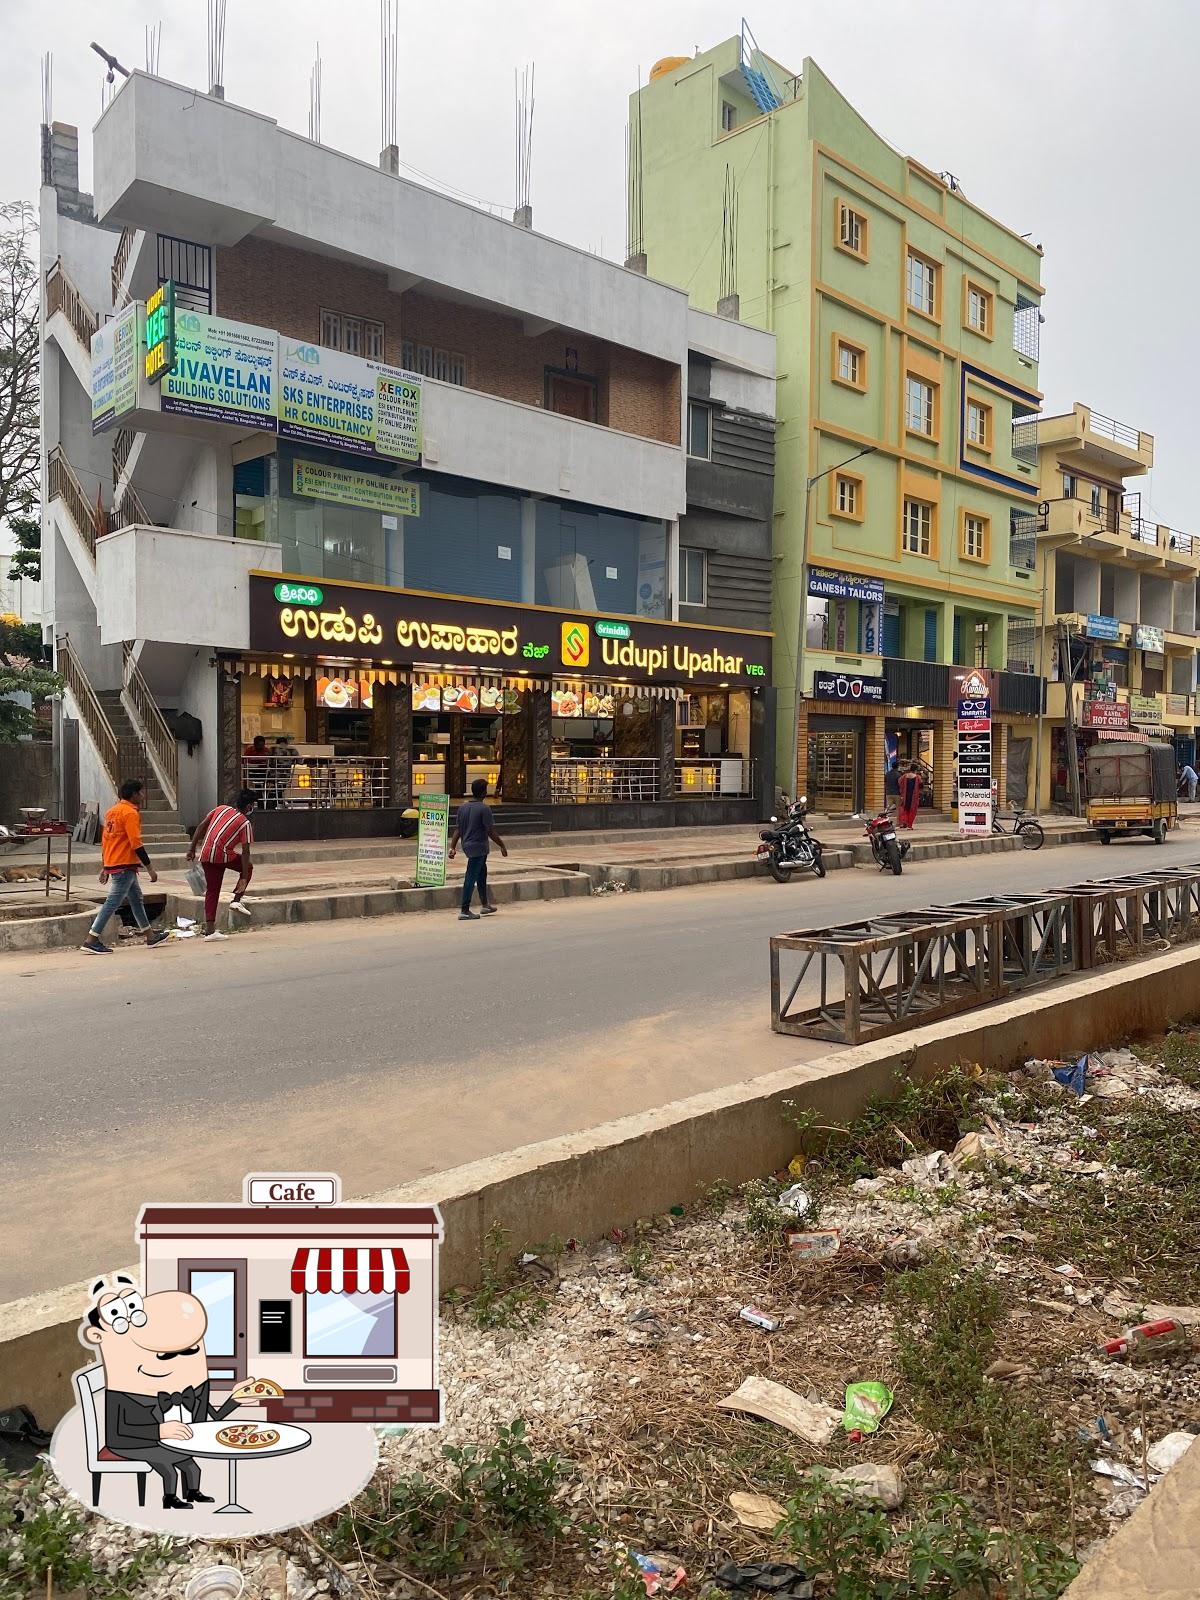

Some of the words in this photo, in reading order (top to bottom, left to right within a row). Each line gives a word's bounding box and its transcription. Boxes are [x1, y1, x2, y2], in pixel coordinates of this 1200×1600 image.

[147, 305, 165, 350] VEG
[146, 341, 165, 379] HOTEL
[168, 379, 215, 401] BUILDING
[218, 389, 271, 411] SOLUTIONS
[378, 393, 403, 404] COLOUR
[403, 399, 418, 409] PRINT
[380, 381, 417, 400] XEROX
[283, 385, 304, 405] SKS
[306, 391, 374, 422] ENTERPRISES
[386, 404, 418, 417] ENTITLEMENT
[284, 406, 299, 420] HR
[301, 410, 372, 437] CONSULTANCY
[377, 416, 384, 424] PF
[384, 419, 402, 429] ONLINE
[402, 423, 417, 433] APPLY
[305, 467, 332, 479] COLOUR
[333, 472, 352, 483] PRINT
[356, 477, 364, 486] PF
[366, 479, 389, 490] ONLINE
[390, 484, 409, 494] APPLY
[314, 479, 351, 493] ENTITLEMENT
[354, 487, 393, 501] CONTRIBUTION
[279, 584, 318, 604] ಶ್ರೀನಿಧಿ
[810, 580, 846, 595] GANESH
[848, 587, 883, 602] TAILORS
[280, 606, 383, 645] ಉಡುಪಿ
[397, 619, 518, 656] ಉಪಾಹಾರ
[521, 642, 549, 660] ವೆಜ್
[597, 622, 630, 637] Srinidhi
[602, 638, 668, 676] Udupi
[673, 645, 744, 679] Upahar
[746, 664, 766, 676] VEG.
[1092, 715, 1108, 724] HOT
[1108, 716, 1128, 726] CHIPS
[965, 791, 991, 799] Polaroid
[421, 811, 445, 821] XEROX
